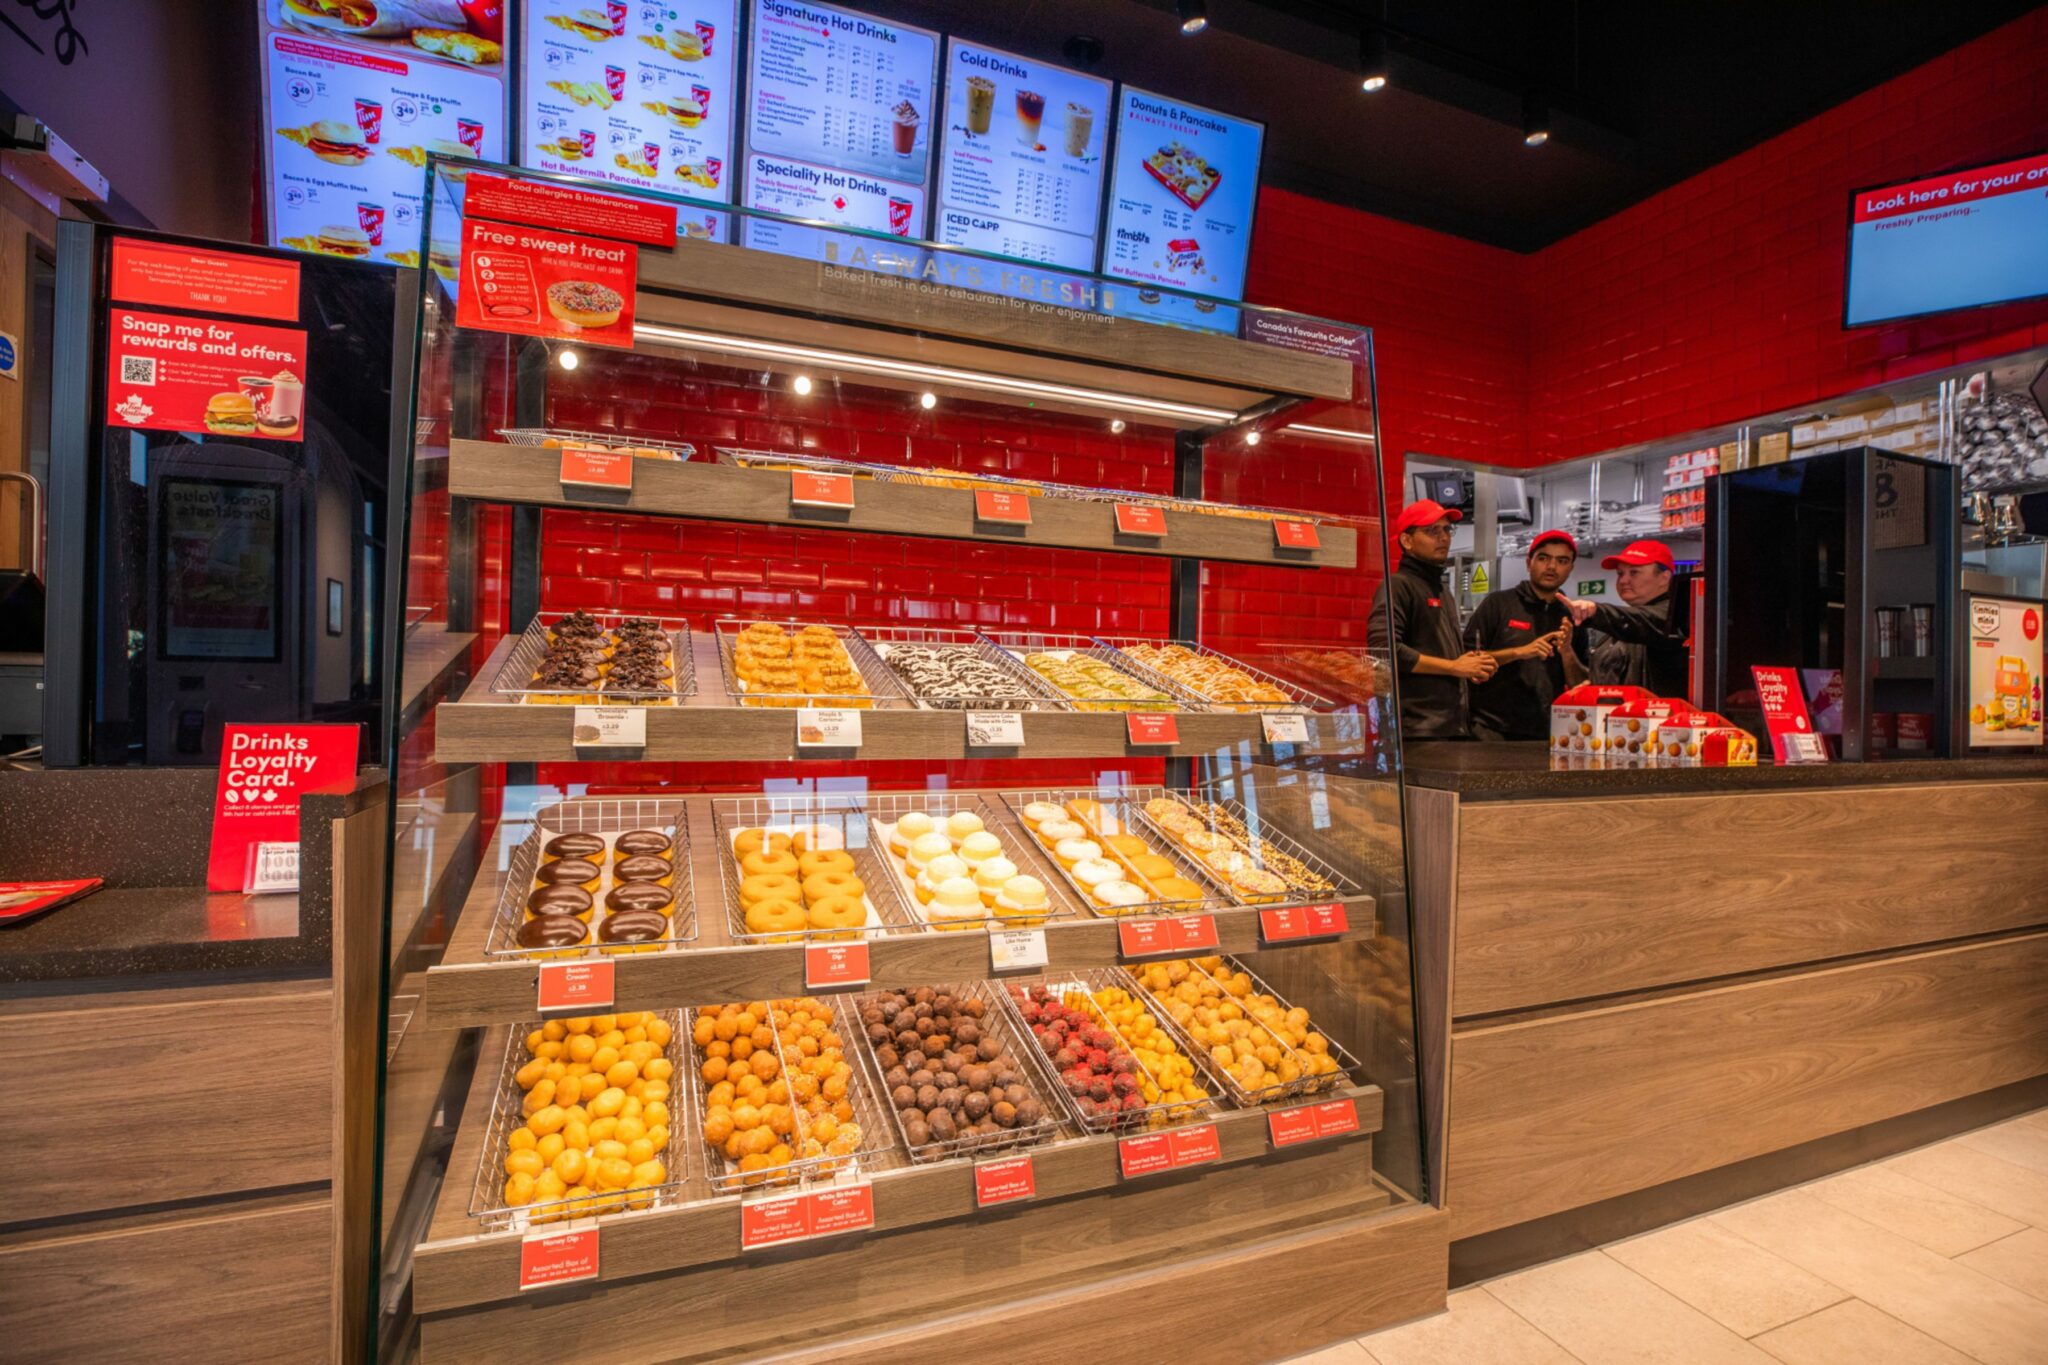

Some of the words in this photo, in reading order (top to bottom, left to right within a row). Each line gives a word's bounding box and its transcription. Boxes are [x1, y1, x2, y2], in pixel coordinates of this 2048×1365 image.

[763, 0, 828, 25] Signature
[832, 15, 854, 30] Hot
[857, 22, 896, 44] Drinks
[960, 51, 988, 68] Cold
[990, 58, 1028, 80] Drinks
[1131, 97, 1168, 118] Donuts
[1170, 106, 1178, 118] &
[1180, 112, 1228, 134] Pancakes
[541, 160, 557, 170] Hot
[560, 164, 607, 180] Buttermilk
[609, 172, 651, 188] Pancakes
[757, 158, 821, 186] Speciality
[824, 172, 846, 188] Hot
[848, 178, 888, 196] Drinks
[508, 182, 532, 192] Food
[534, 187, 573, 199] allergies
[584, 195, 639, 210] intolerances
[1866, 194, 1906, 213] Look
[1910, 186, 1949, 204] here
[1953, 180, 1980, 195] for
[1982, 172, 2024, 193] your
[947, 214, 970, 226] ICED
[1874, 218, 1914, 232] Freshly
[472, 226, 516, 245] Free
[521, 236, 577, 256] sweet
[581, 244, 626, 262] treat
[850, 245, 984, 287] ALWAYS
[1001, 271, 1096, 307] FRESH
[190, 292, 210, 302] THANK
[824, 266, 866, 283] Baked
[870, 275, 902, 289] fresh
[906, 280, 917, 290] in
[920, 284, 941, 295] our
[944, 288, 1006, 306] restaurant
[1010, 296, 1026, 308] for
[1029, 302, 1054, 314] your
[1057, 306, 1116, 324] enjoyment
[122, 316, 170, 336] Snap
[176, 326, 203, 338] me
[208, 325, 234, 340] for
[1256, 320, 1293, 334] Canada's
[1294, 327, 1328, 341] Favourite
[122, 333, 198, 352] rewards
[202, 342, 236, 356] and
[240, 345, 297, 363] offers.
[1756, 671, 1782, 682] Drinks
[1759, 682, 1788, 695] Loyalty
[232, 732, 310, 750] Drinks
[230, 751, 318, 773] Loyalty
[226, 770, 296, 787] Card.
[754, 1204, 766, 1212] Old
[781, 1222, 793, 1230] Box
[542, 1238, 566, 1247] Honey
[566, 1236, 580, 1244] Dip
[532, 1262, 564, 1273] Assorted
[565, 1260, 578, 1268] Box
[580, 1257, 589, 1265] of
